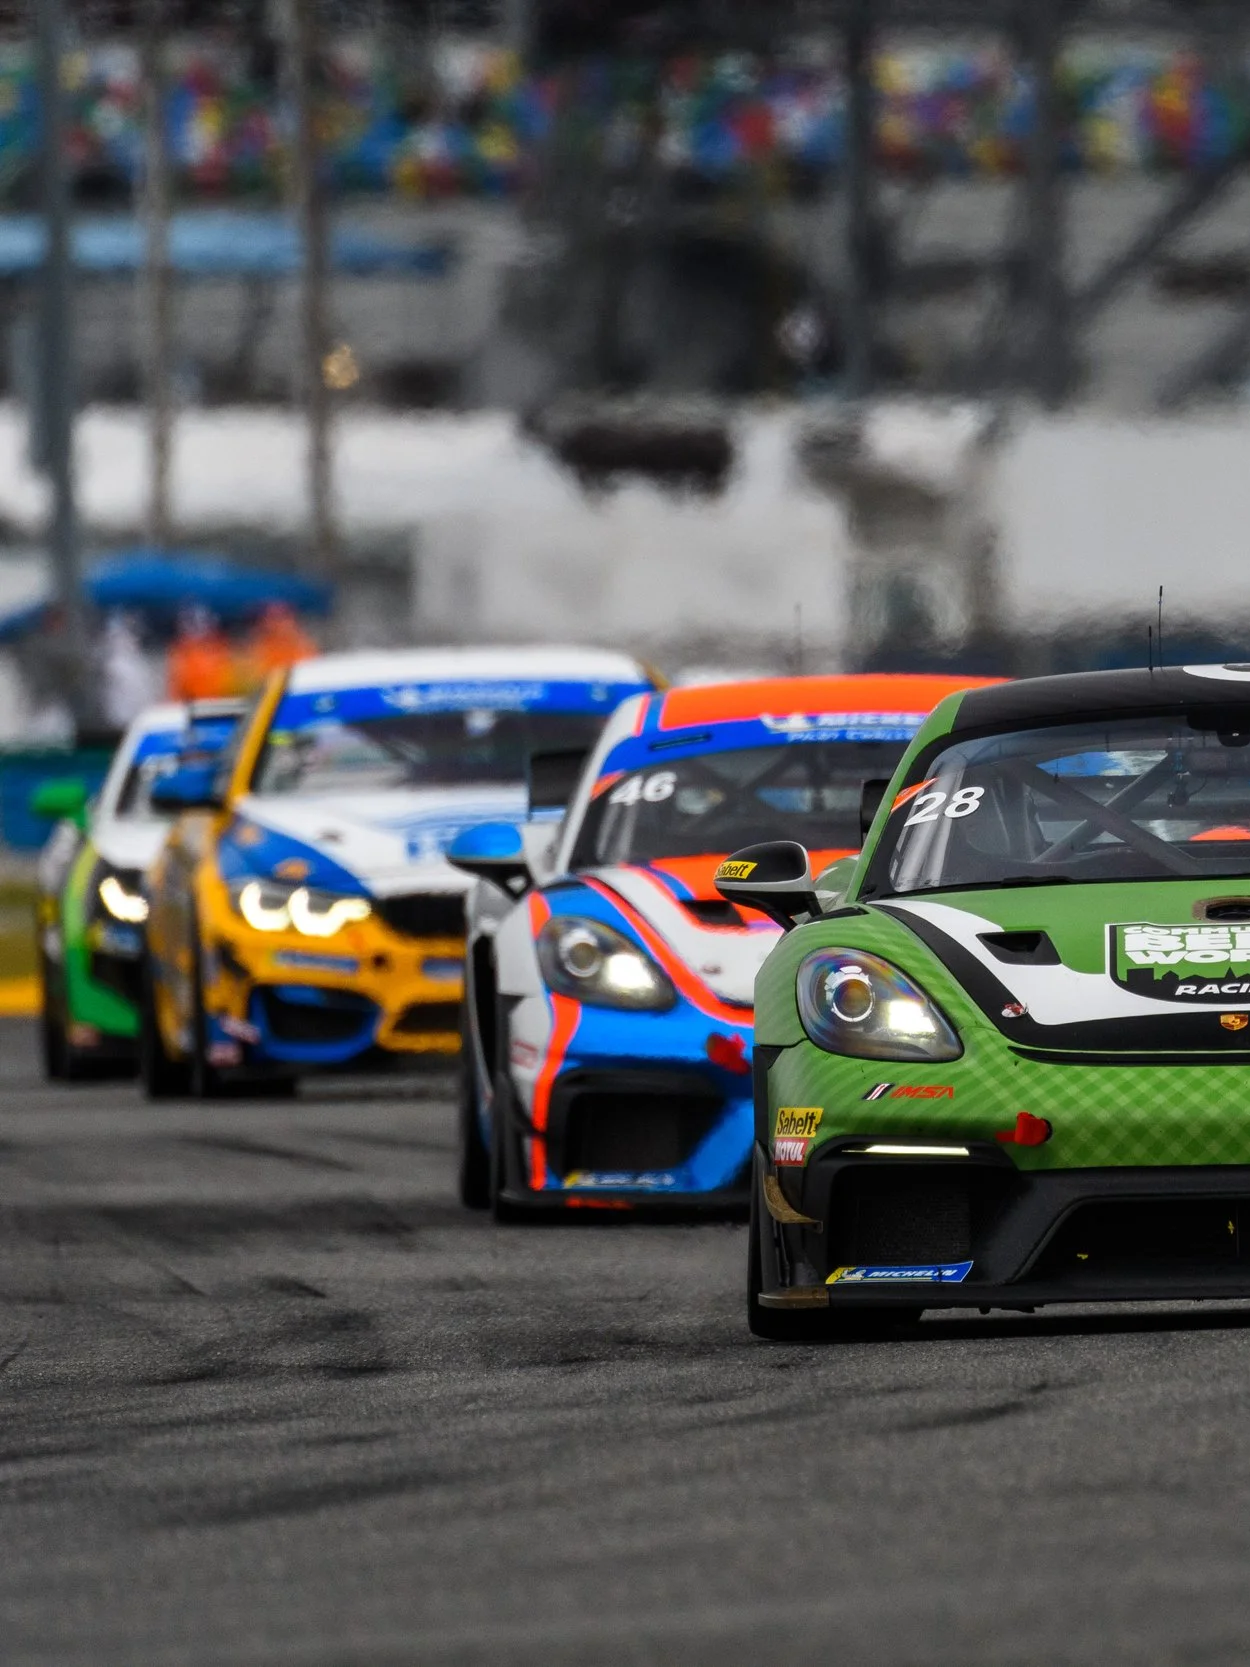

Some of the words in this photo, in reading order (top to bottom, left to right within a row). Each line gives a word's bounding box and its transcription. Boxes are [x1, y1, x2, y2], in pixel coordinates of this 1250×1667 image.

[609, 771, 677, 806] 46
[904, 786, 985, 827] 28
[890, 1086, 954, 1099] IMSA
[777, 1110, 816, 1136] Sabelt
[775, 1140, 803, 1161] MOTUL
